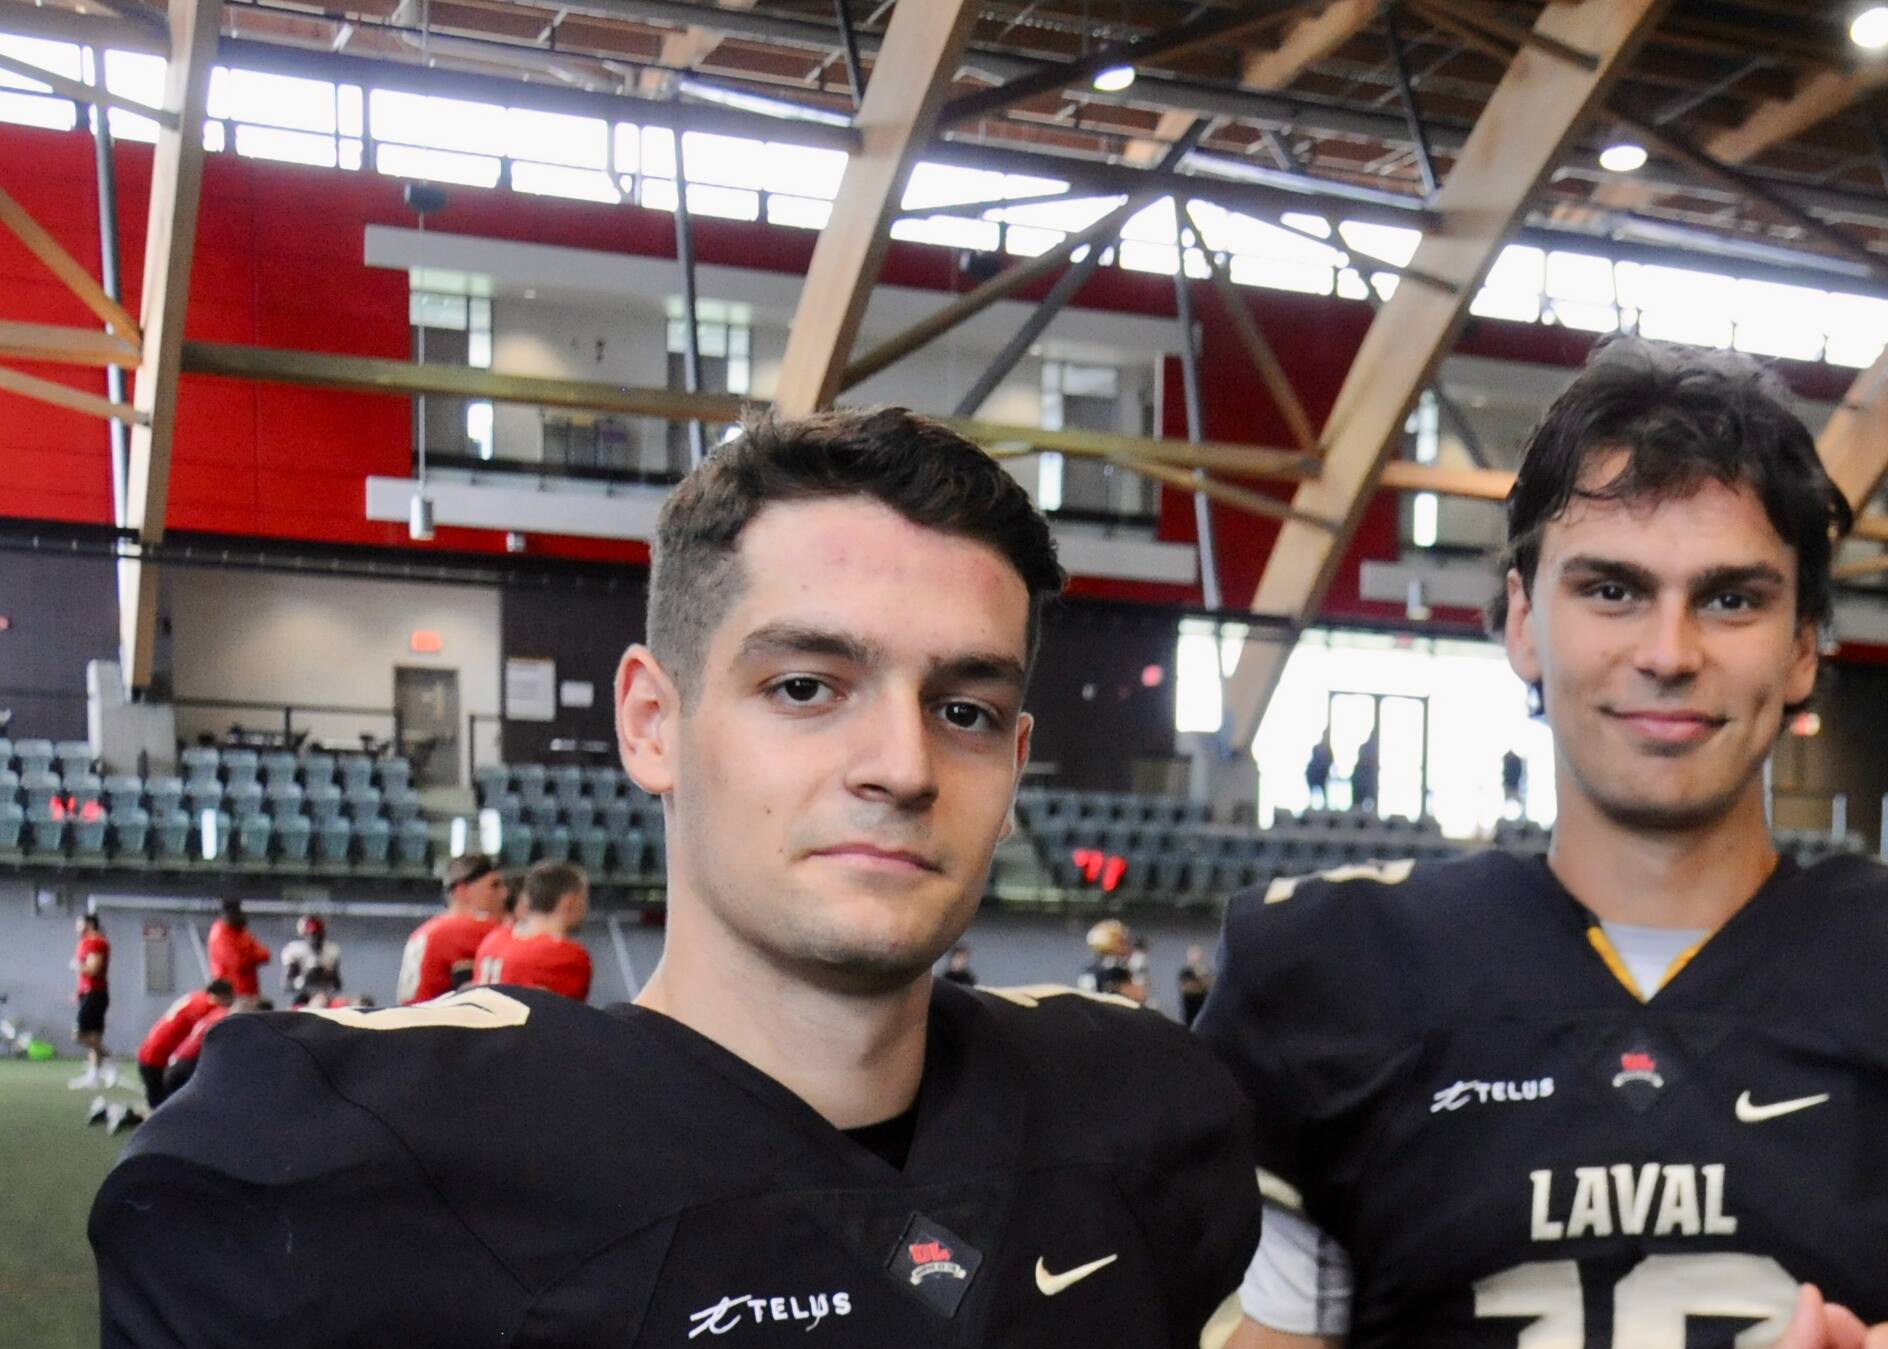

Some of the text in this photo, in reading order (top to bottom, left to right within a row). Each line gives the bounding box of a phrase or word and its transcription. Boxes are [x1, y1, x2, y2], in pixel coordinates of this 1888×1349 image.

[1475, 1077, 1555, 1104] TELUS
[1530, 1162, 1738, 1242] LAVAL
[747, 1292, 852, 1324] TELUS
